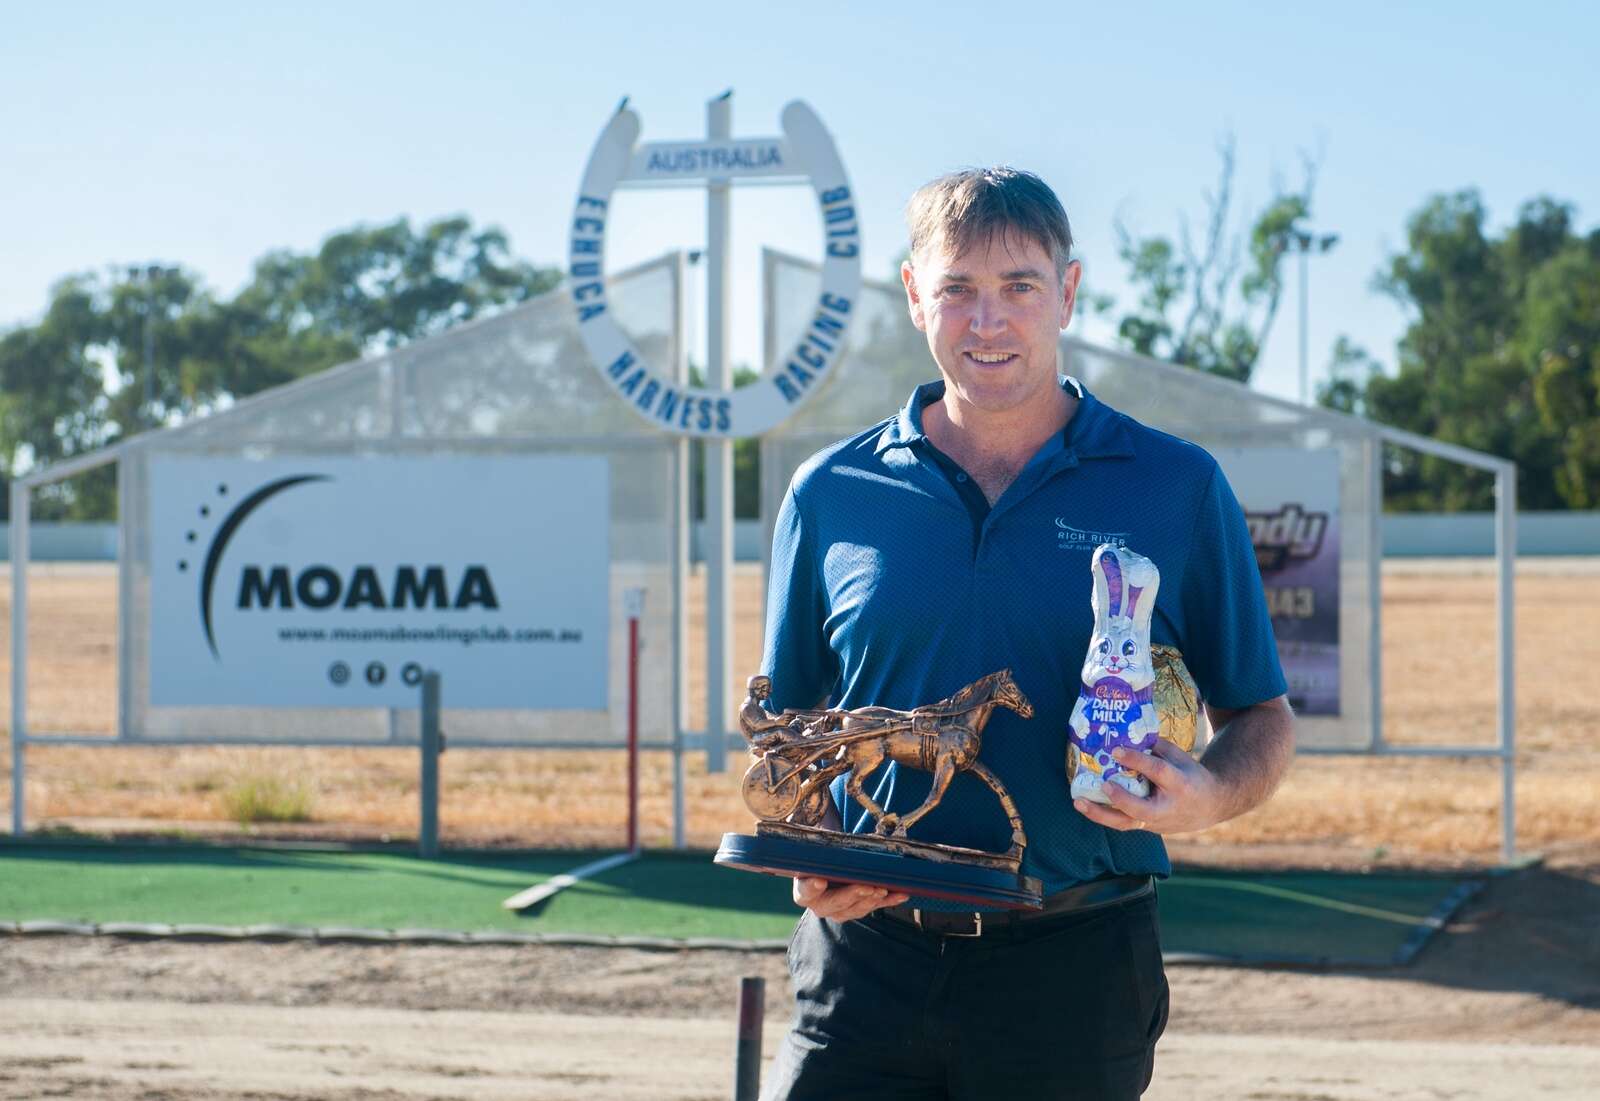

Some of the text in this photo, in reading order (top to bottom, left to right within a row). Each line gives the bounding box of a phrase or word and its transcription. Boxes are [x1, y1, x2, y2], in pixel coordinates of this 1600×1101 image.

[647, 147, 783, 172] AUSTRALIA
[570, 185, 858, 433] ECHUCA HARNESS RACING CLUB
[1058, 531, 1126, 547] RICH RIVER
[236, 566, 500, 610] MOAMA
[278, 627, 583, 646] www.moamabowlingclub.com.au
[1092, 698, 1131, 711] DAIRY
[1092, 710, 1126, 723] MILK
